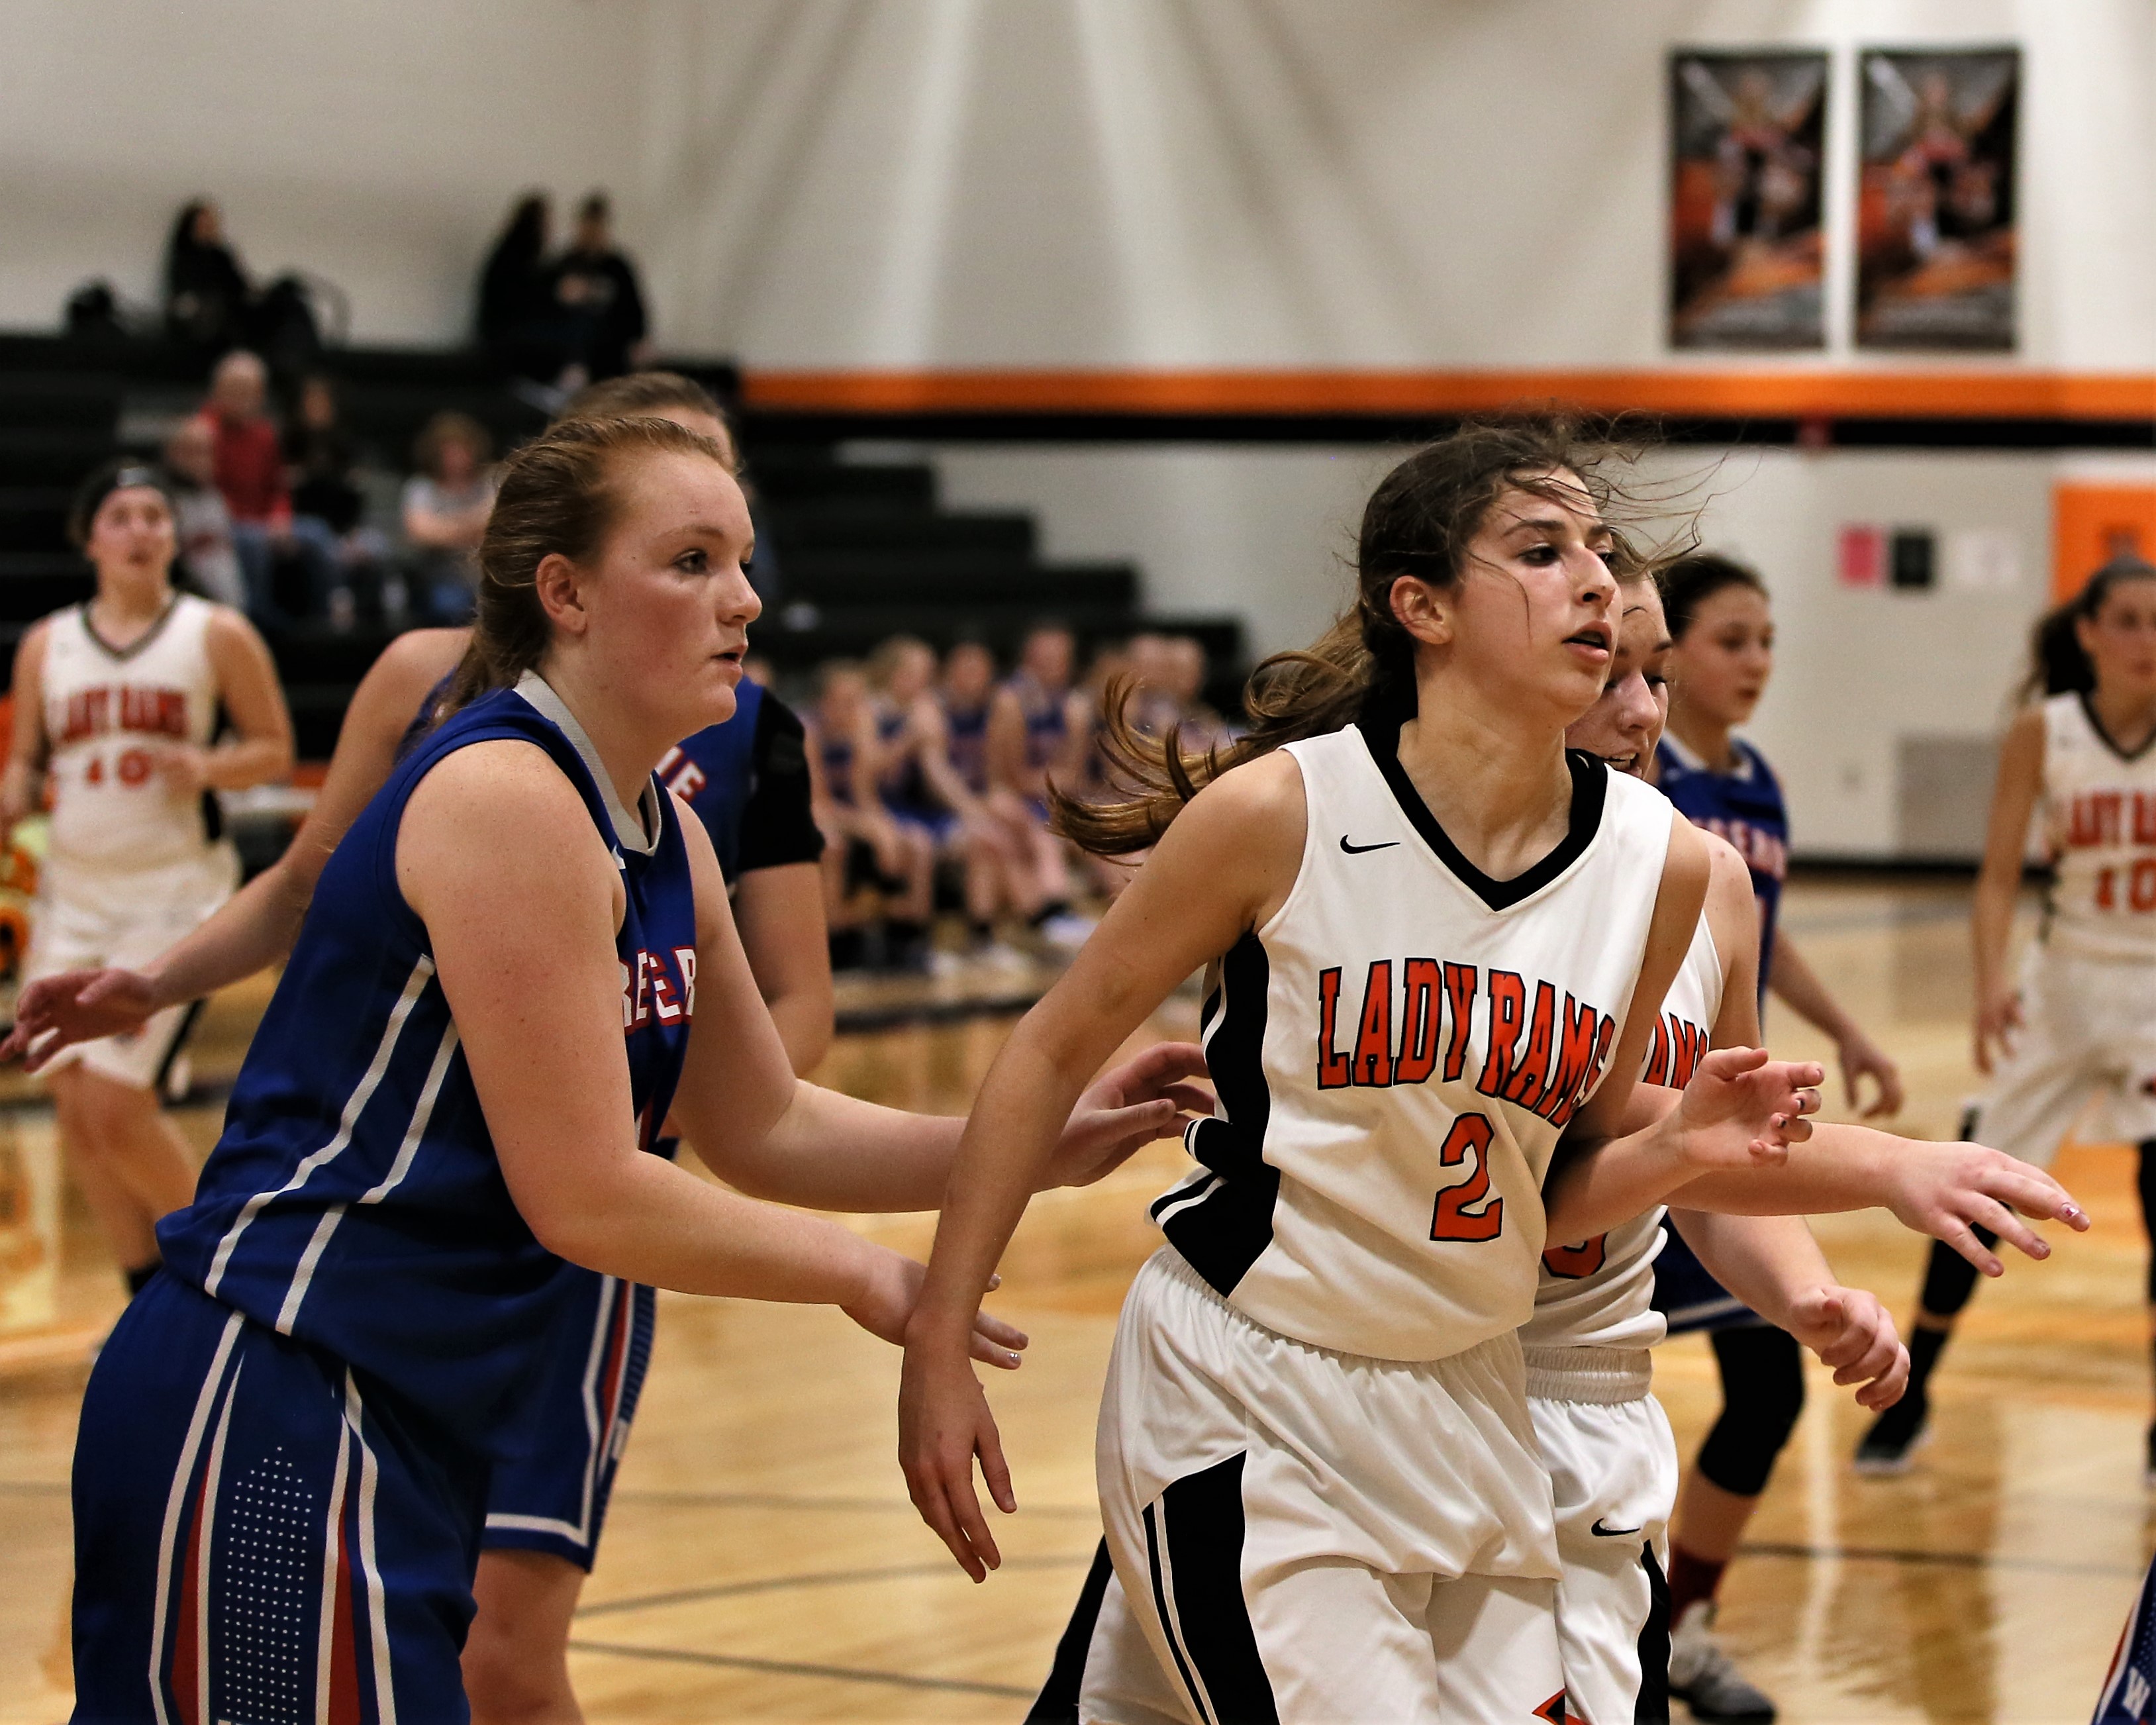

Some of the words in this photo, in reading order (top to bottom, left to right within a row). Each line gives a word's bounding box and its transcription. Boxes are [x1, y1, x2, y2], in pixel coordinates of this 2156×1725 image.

[1316, 957, 1478, 1091] LADY
[1475, 968, 1616, 1129] RAMS
[1429, 1111, 1503, 1243] 2
